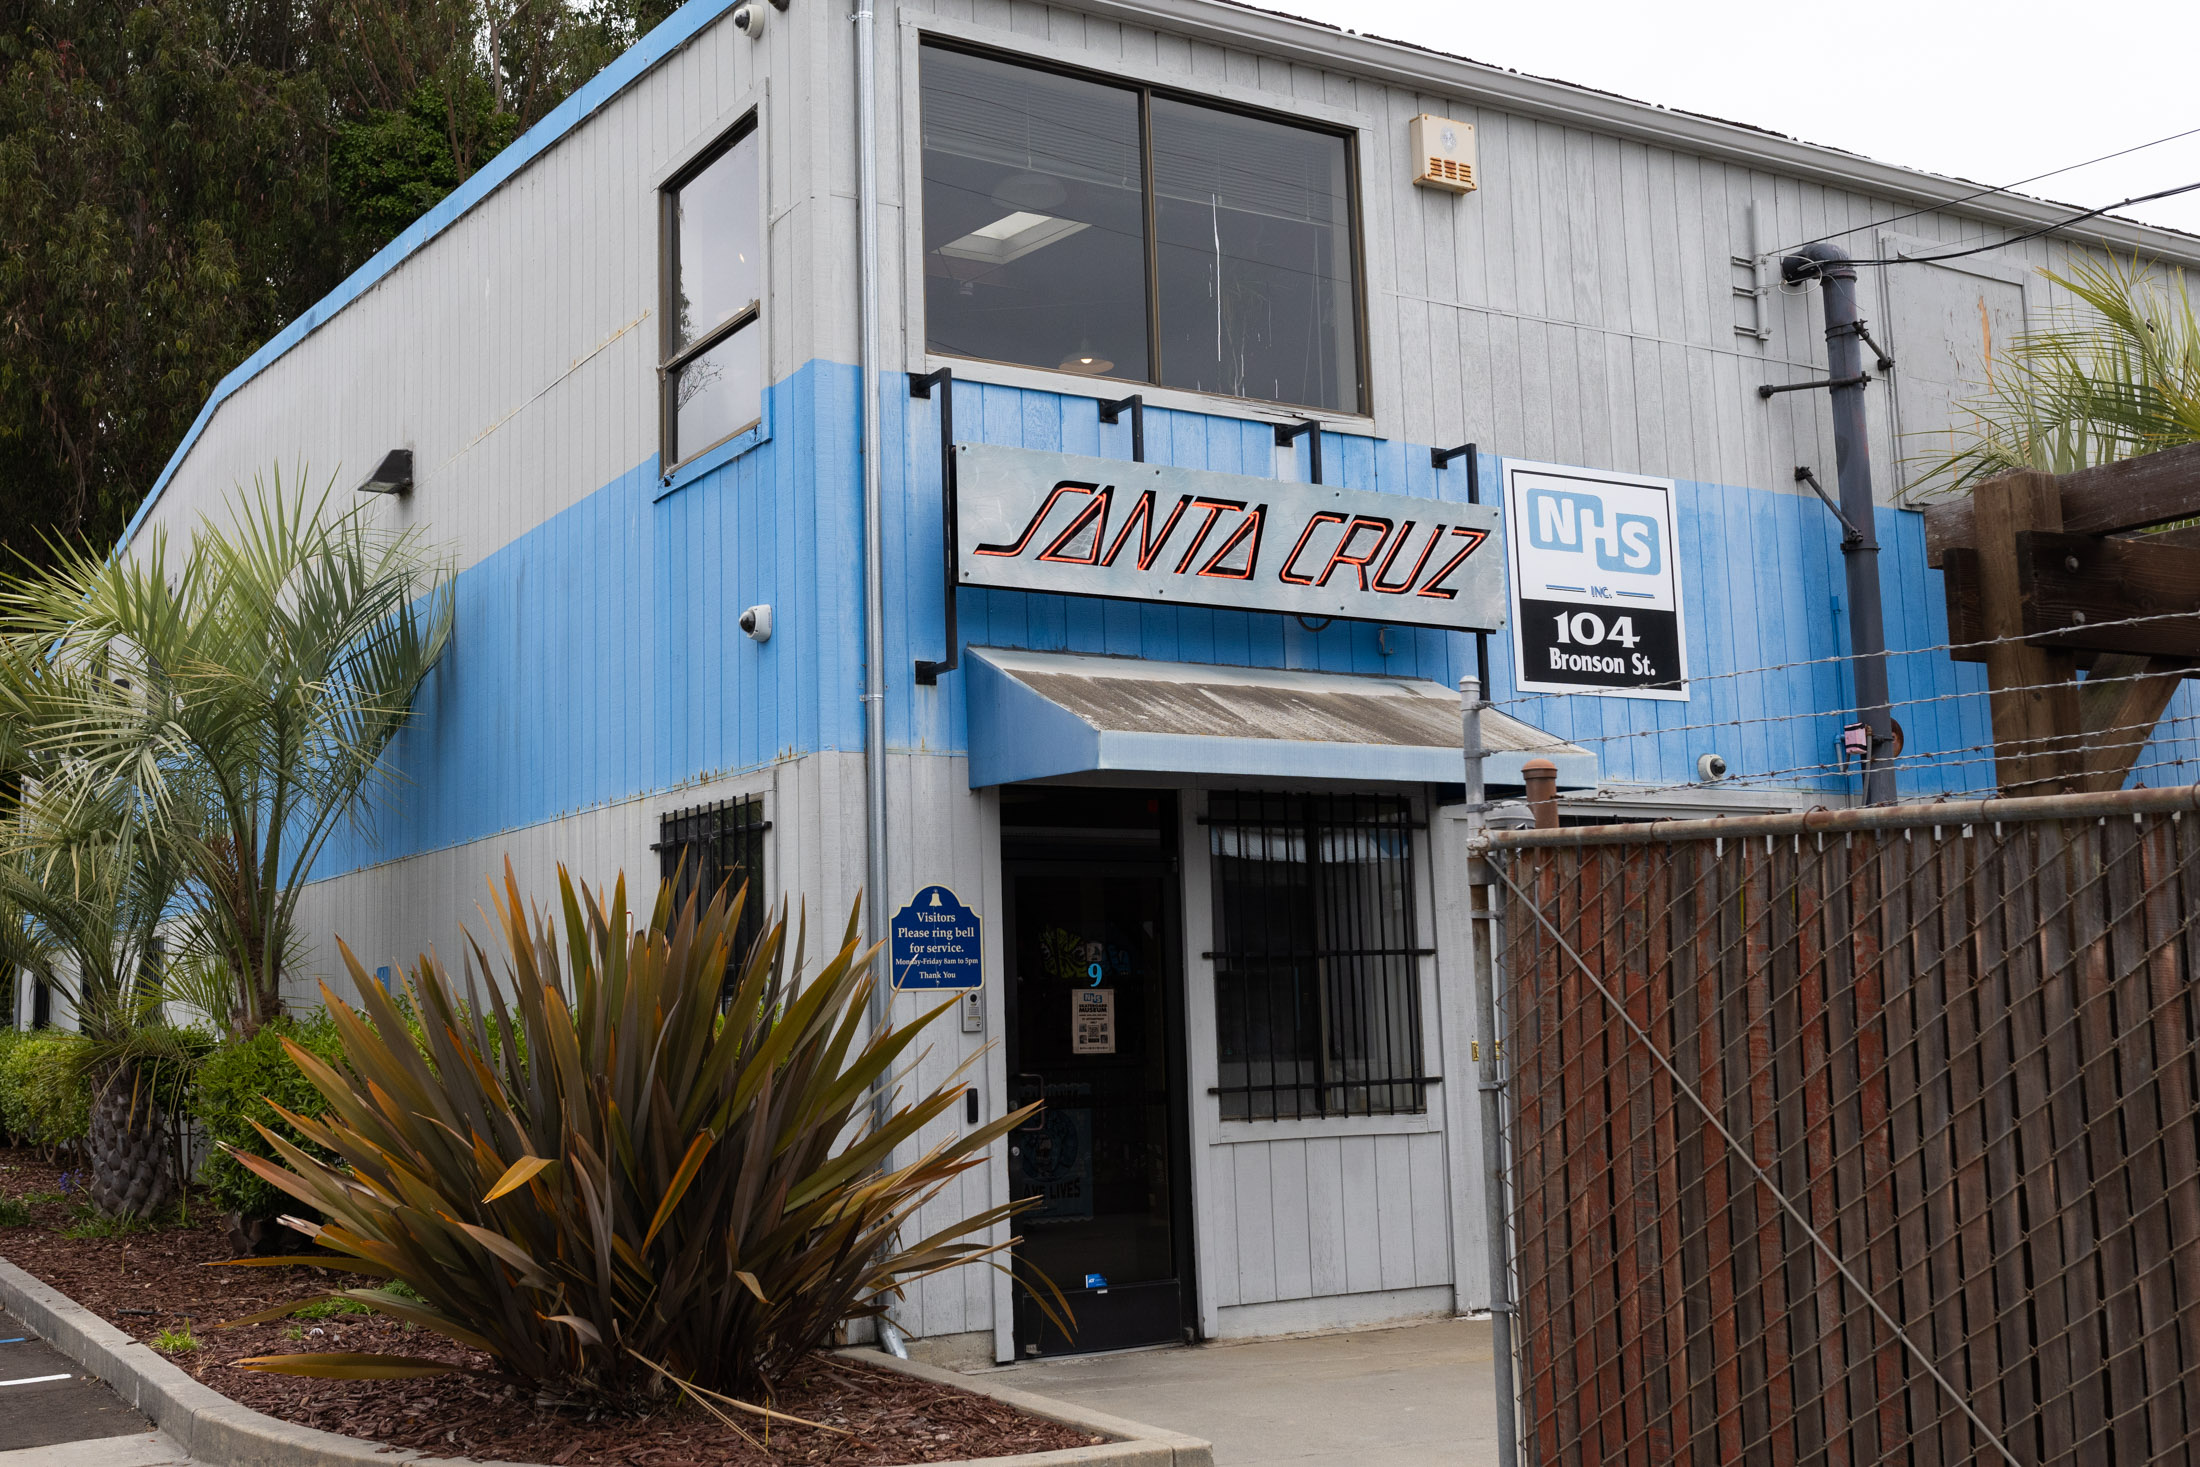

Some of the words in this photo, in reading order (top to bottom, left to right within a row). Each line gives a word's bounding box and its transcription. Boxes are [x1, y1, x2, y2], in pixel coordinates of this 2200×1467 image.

[1536, 495, 1652, 569] NHS
[973, 480, 1268, 581] SANTA
[1279, 511, 1491, 600] CRUZ
[1590, 585, 1613, 599] INC.
[1553, 610, 1641, 649] 104
[1549, 647, 1625, 674] Bronson
[1632, 652, 1656, 676] St.
[916, 911, 956, 923] Visitors
[897, 927, 930, 938] Please
[932, 927, 953, 941] ring
[955, 926, 975, 938] bell
[909, 942, 924, 953] for
[926, 942, 964, 953] service.
[943, 957, 957, 965] 8am
[957, 957, 964, 965] to
[964, 957, 979, 967] 5pm
[919, 971, 941, 979] Thank
[943, 971, 956, 979] You
[1087, 962, 1103, 988] 9
